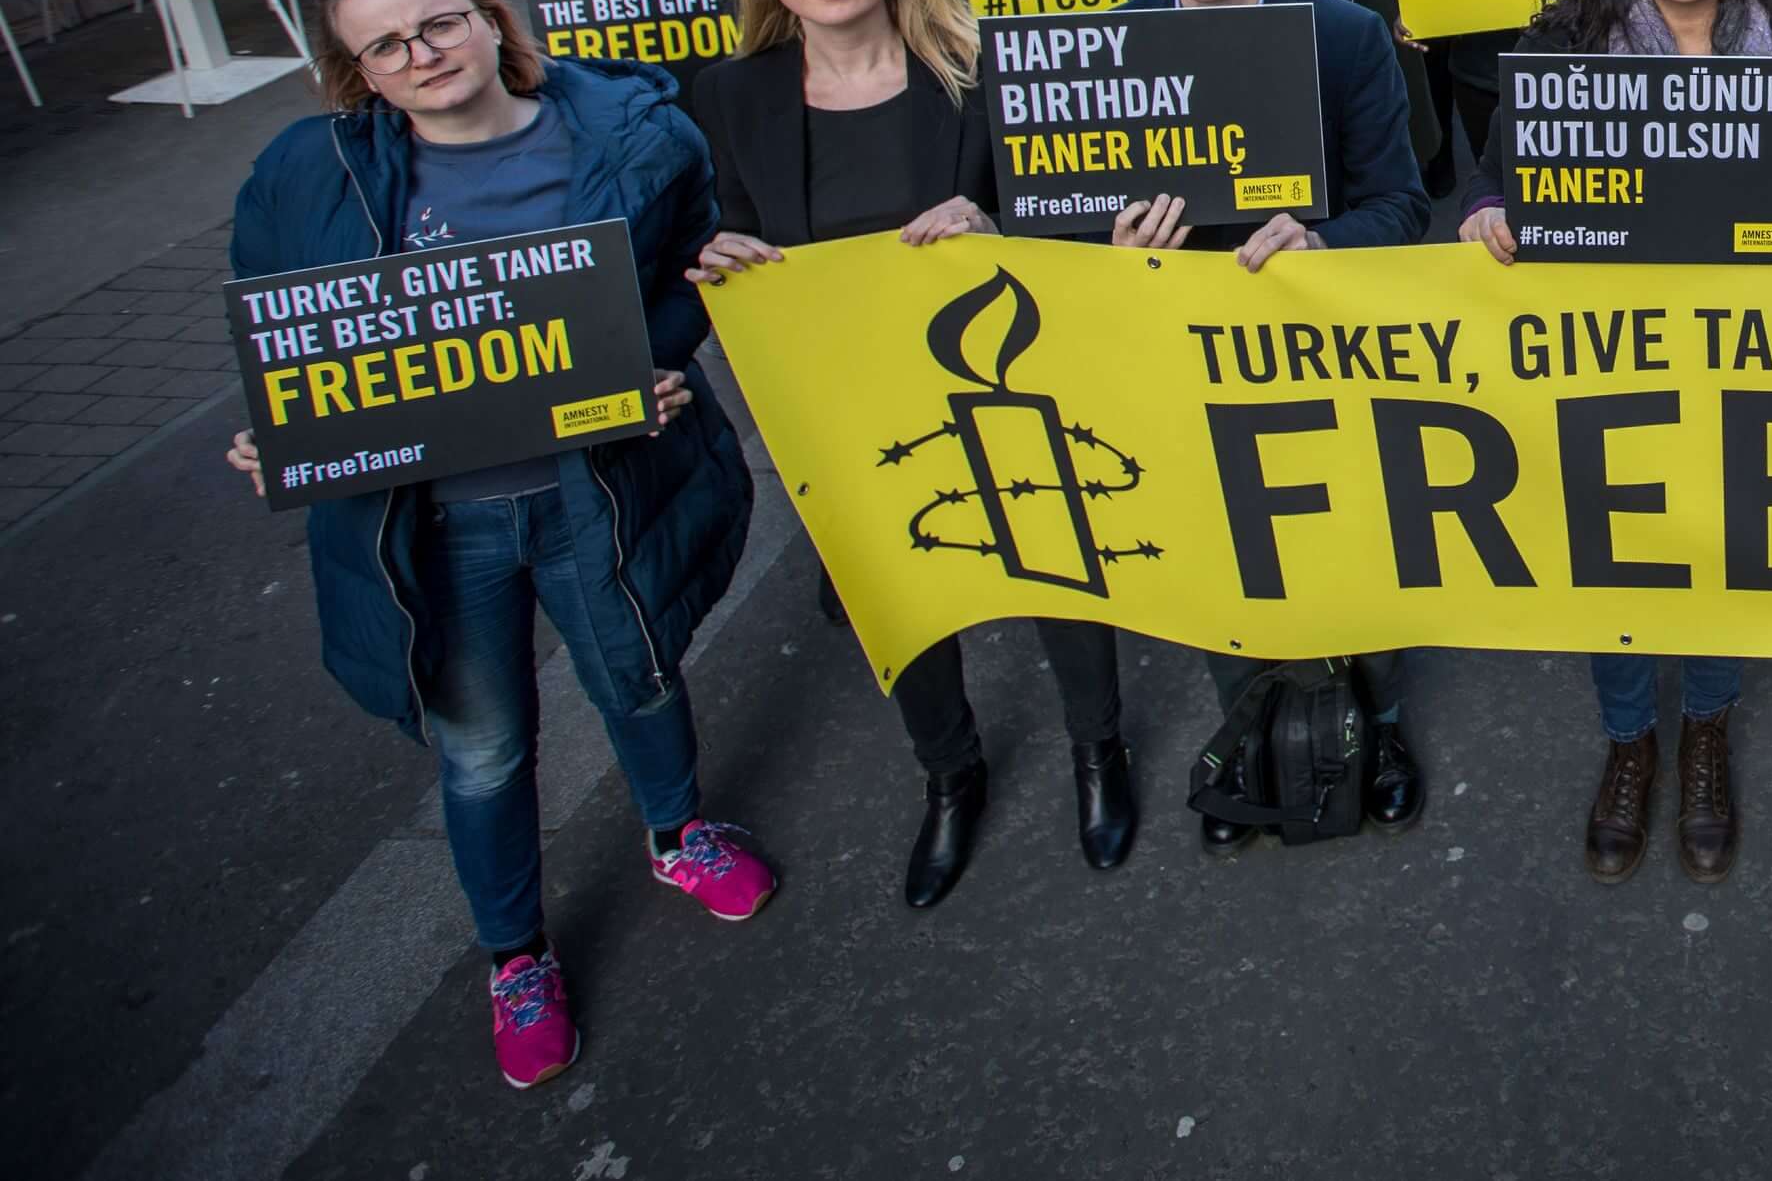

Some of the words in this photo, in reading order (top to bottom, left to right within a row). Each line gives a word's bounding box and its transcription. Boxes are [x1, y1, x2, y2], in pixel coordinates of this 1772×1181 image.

[539, 0, 587, 27] THE
[994, 25, 1128, 73] HAPPY
[1000, 75, 1195, 125] BIRTHDAY
[1514, 63, 1648, 111] DOĞUM
[1004, 130, 1133, 177] TANER
[1145, 124, 1247, 175] KILIÇ
[1515, 120, 1628, 158] KUTLU
[1642, 121, 1760, 160] OLSUN
[1014, 192, 1128, 218] #FreeTaner
[1242, 184, 1283, 195] AMNESTY
[1515, 167, 1644, 204] TANER!
[1519, 225, 1629, 247] #FreeTaner
[242, 272, 393, 325] TURKEY,
[402, 256, 483, 298] GIVE
[487, 238, 596, 282] TANER
[249, 321, 324, 363] THE
[333, 305, 420, 351] BEST
[430, 290, 516, 331] GIFT:
[263, 318, 574, 426] FREEDOM
[1188, 318, 1481, 394] TURKEY,
[1508, 308, 1670, 381] GIVE
[563, 403, 609, 421] AMNESTY
[282, 443, 425, 489] #FreeTaner
